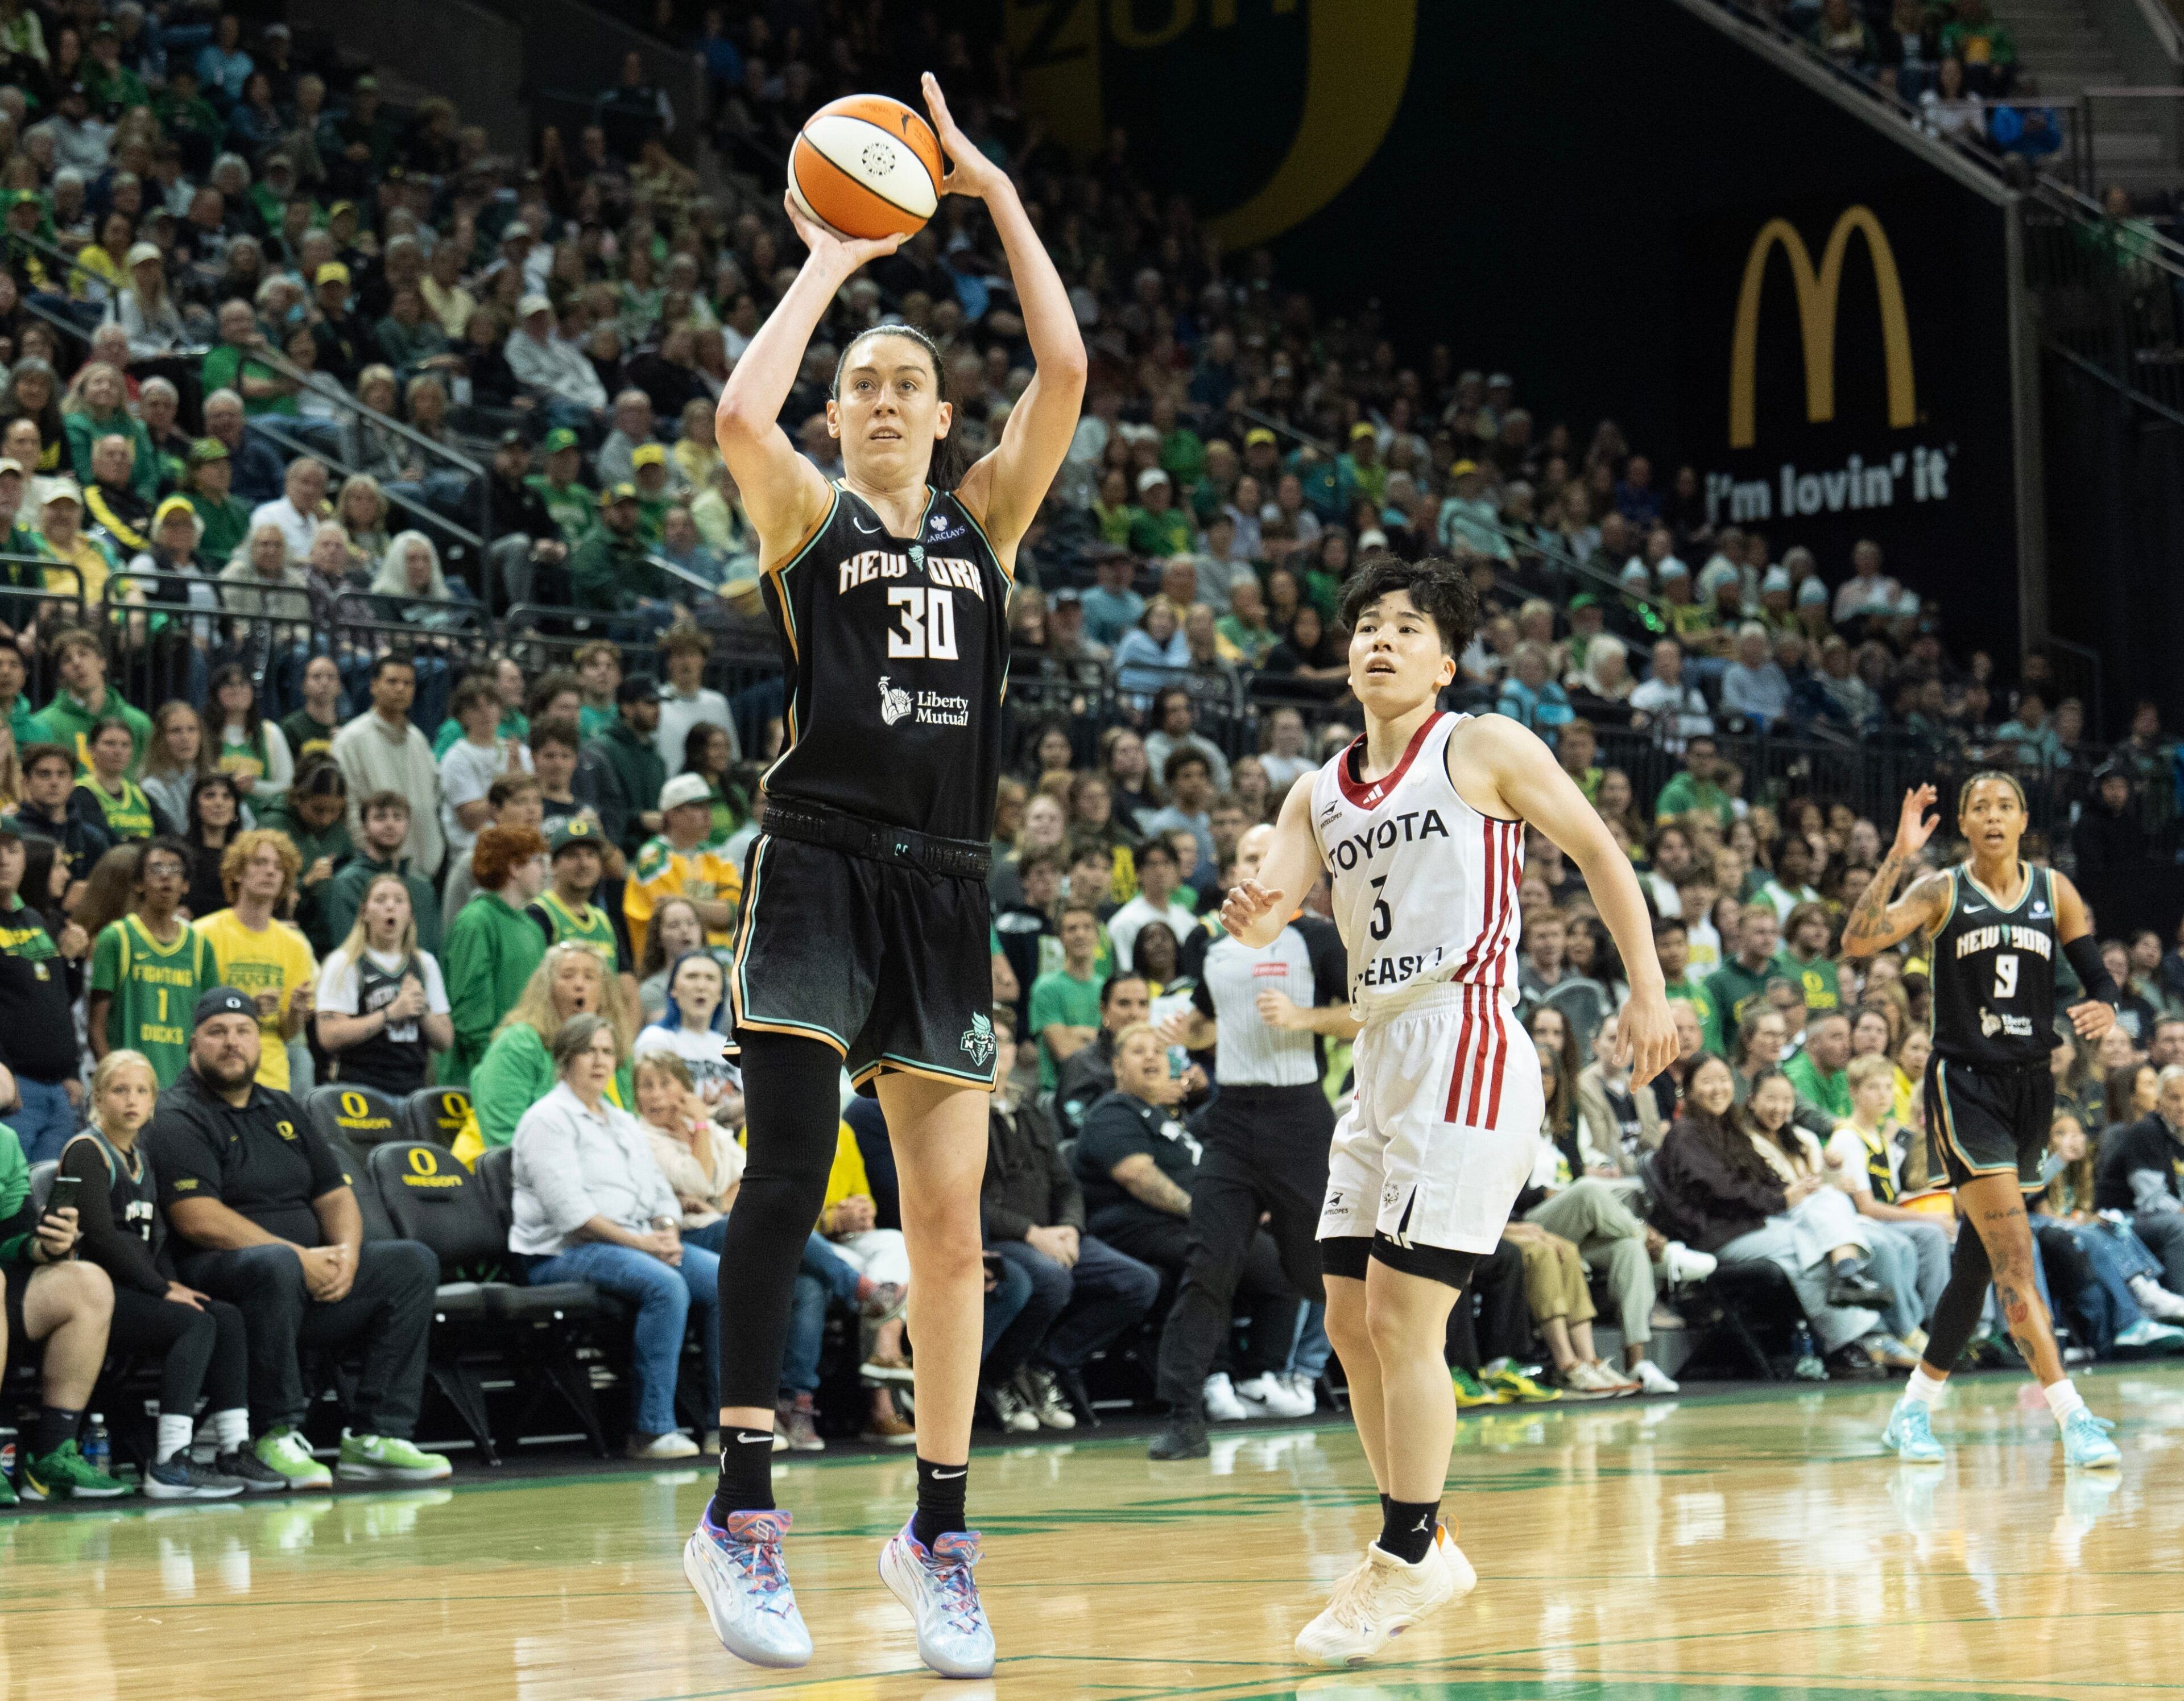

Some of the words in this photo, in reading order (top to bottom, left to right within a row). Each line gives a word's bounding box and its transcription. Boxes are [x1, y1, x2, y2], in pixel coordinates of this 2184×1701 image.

[1780, 453, 1906, 517] lovin'
[1913, 445, 1948, 502] it
[927, 526, 966, 543] ARCLAYS
[839, 550, 908, 596] NEW
[926, 555, 985, 602] ORK
[887, 587, 959, 660] 30
[915, 708, 969, 726] Mutual
[917, 691, 969, 715] Liberty
[1329, 810, 1449, 878] TOYOTA
[1370, 874, 1392, 941] 3
[1956, 924, 2000, 960] NEW
[1993, 954, 2019, 998] 9
